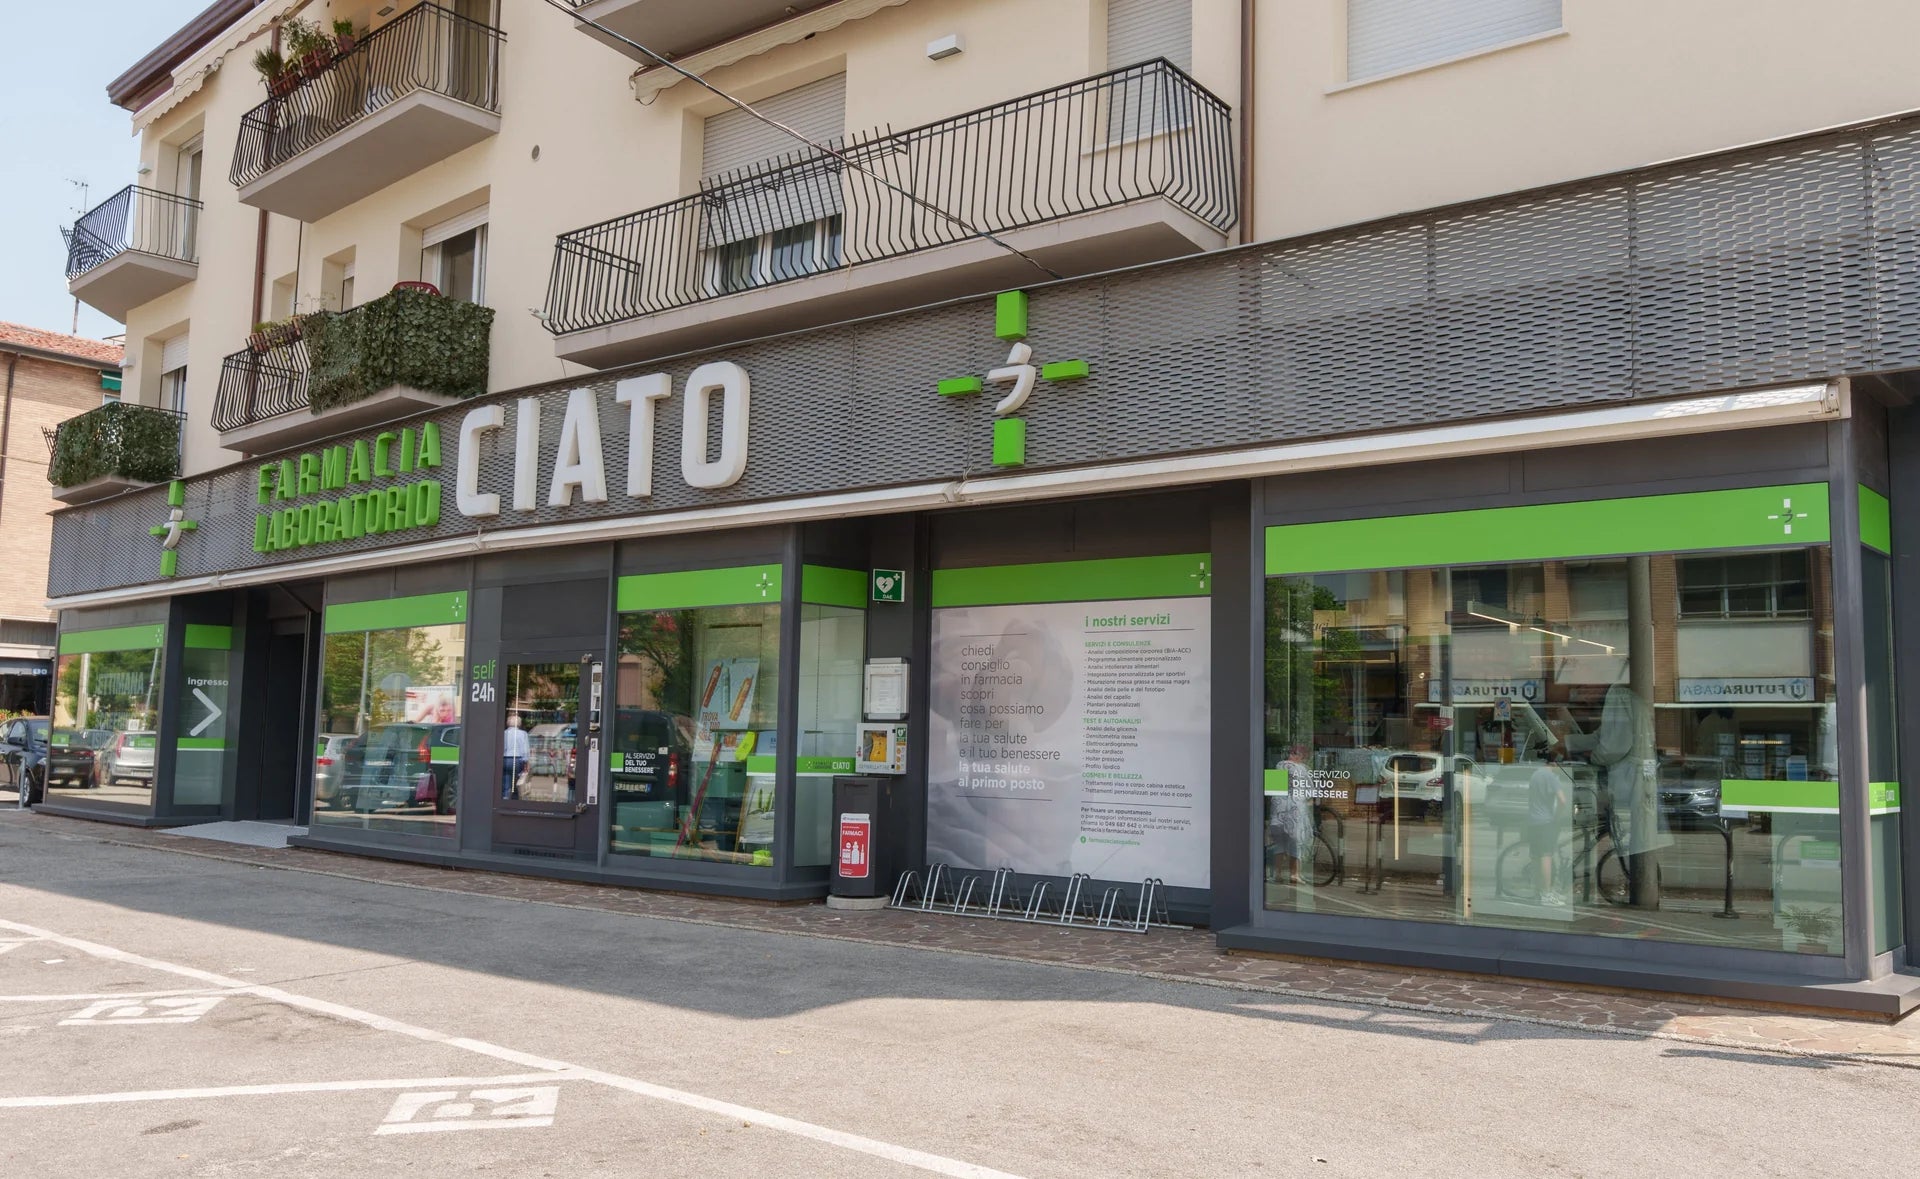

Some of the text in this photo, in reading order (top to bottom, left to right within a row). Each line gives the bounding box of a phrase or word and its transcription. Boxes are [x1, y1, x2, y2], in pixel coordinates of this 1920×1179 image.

[456, 360, 750, 518] CIATO
[258, 421, 442, 504] FARMACIA
[254, 480, 441, 552] LABORATORIO
[1085, 614, 1170, 627] i nostri servizi
[961, 644, 994, 656] chiedi
[472, 659, 496, 680] self
[961, 659, 1010, 672] consiglio
[188, 677, 229, 686] ingresso
[961, 673, 1023, 685] in farmacia
[471, 682, 495, 703] 24h
[961, 688, 994, 701] scopri
[960, 703, 1044, 718] cosa possiamo
[960, 718, 1004, 731] fare per
[959, 733, 1028, 744] la tua salute
[959, 748, 1061, 760] e il tuo benessere
[832, 761, 850, 770] CIATO
[959, 762, 1031, 774] la tua salute
[1292, 770, 1351, 779] AL SERVIZIO
[958, 776, 1045, 791] al primo posto
[1313, 780, 1334, 788] TUO
[1292, 789, 1348, 799] BENESSERE
